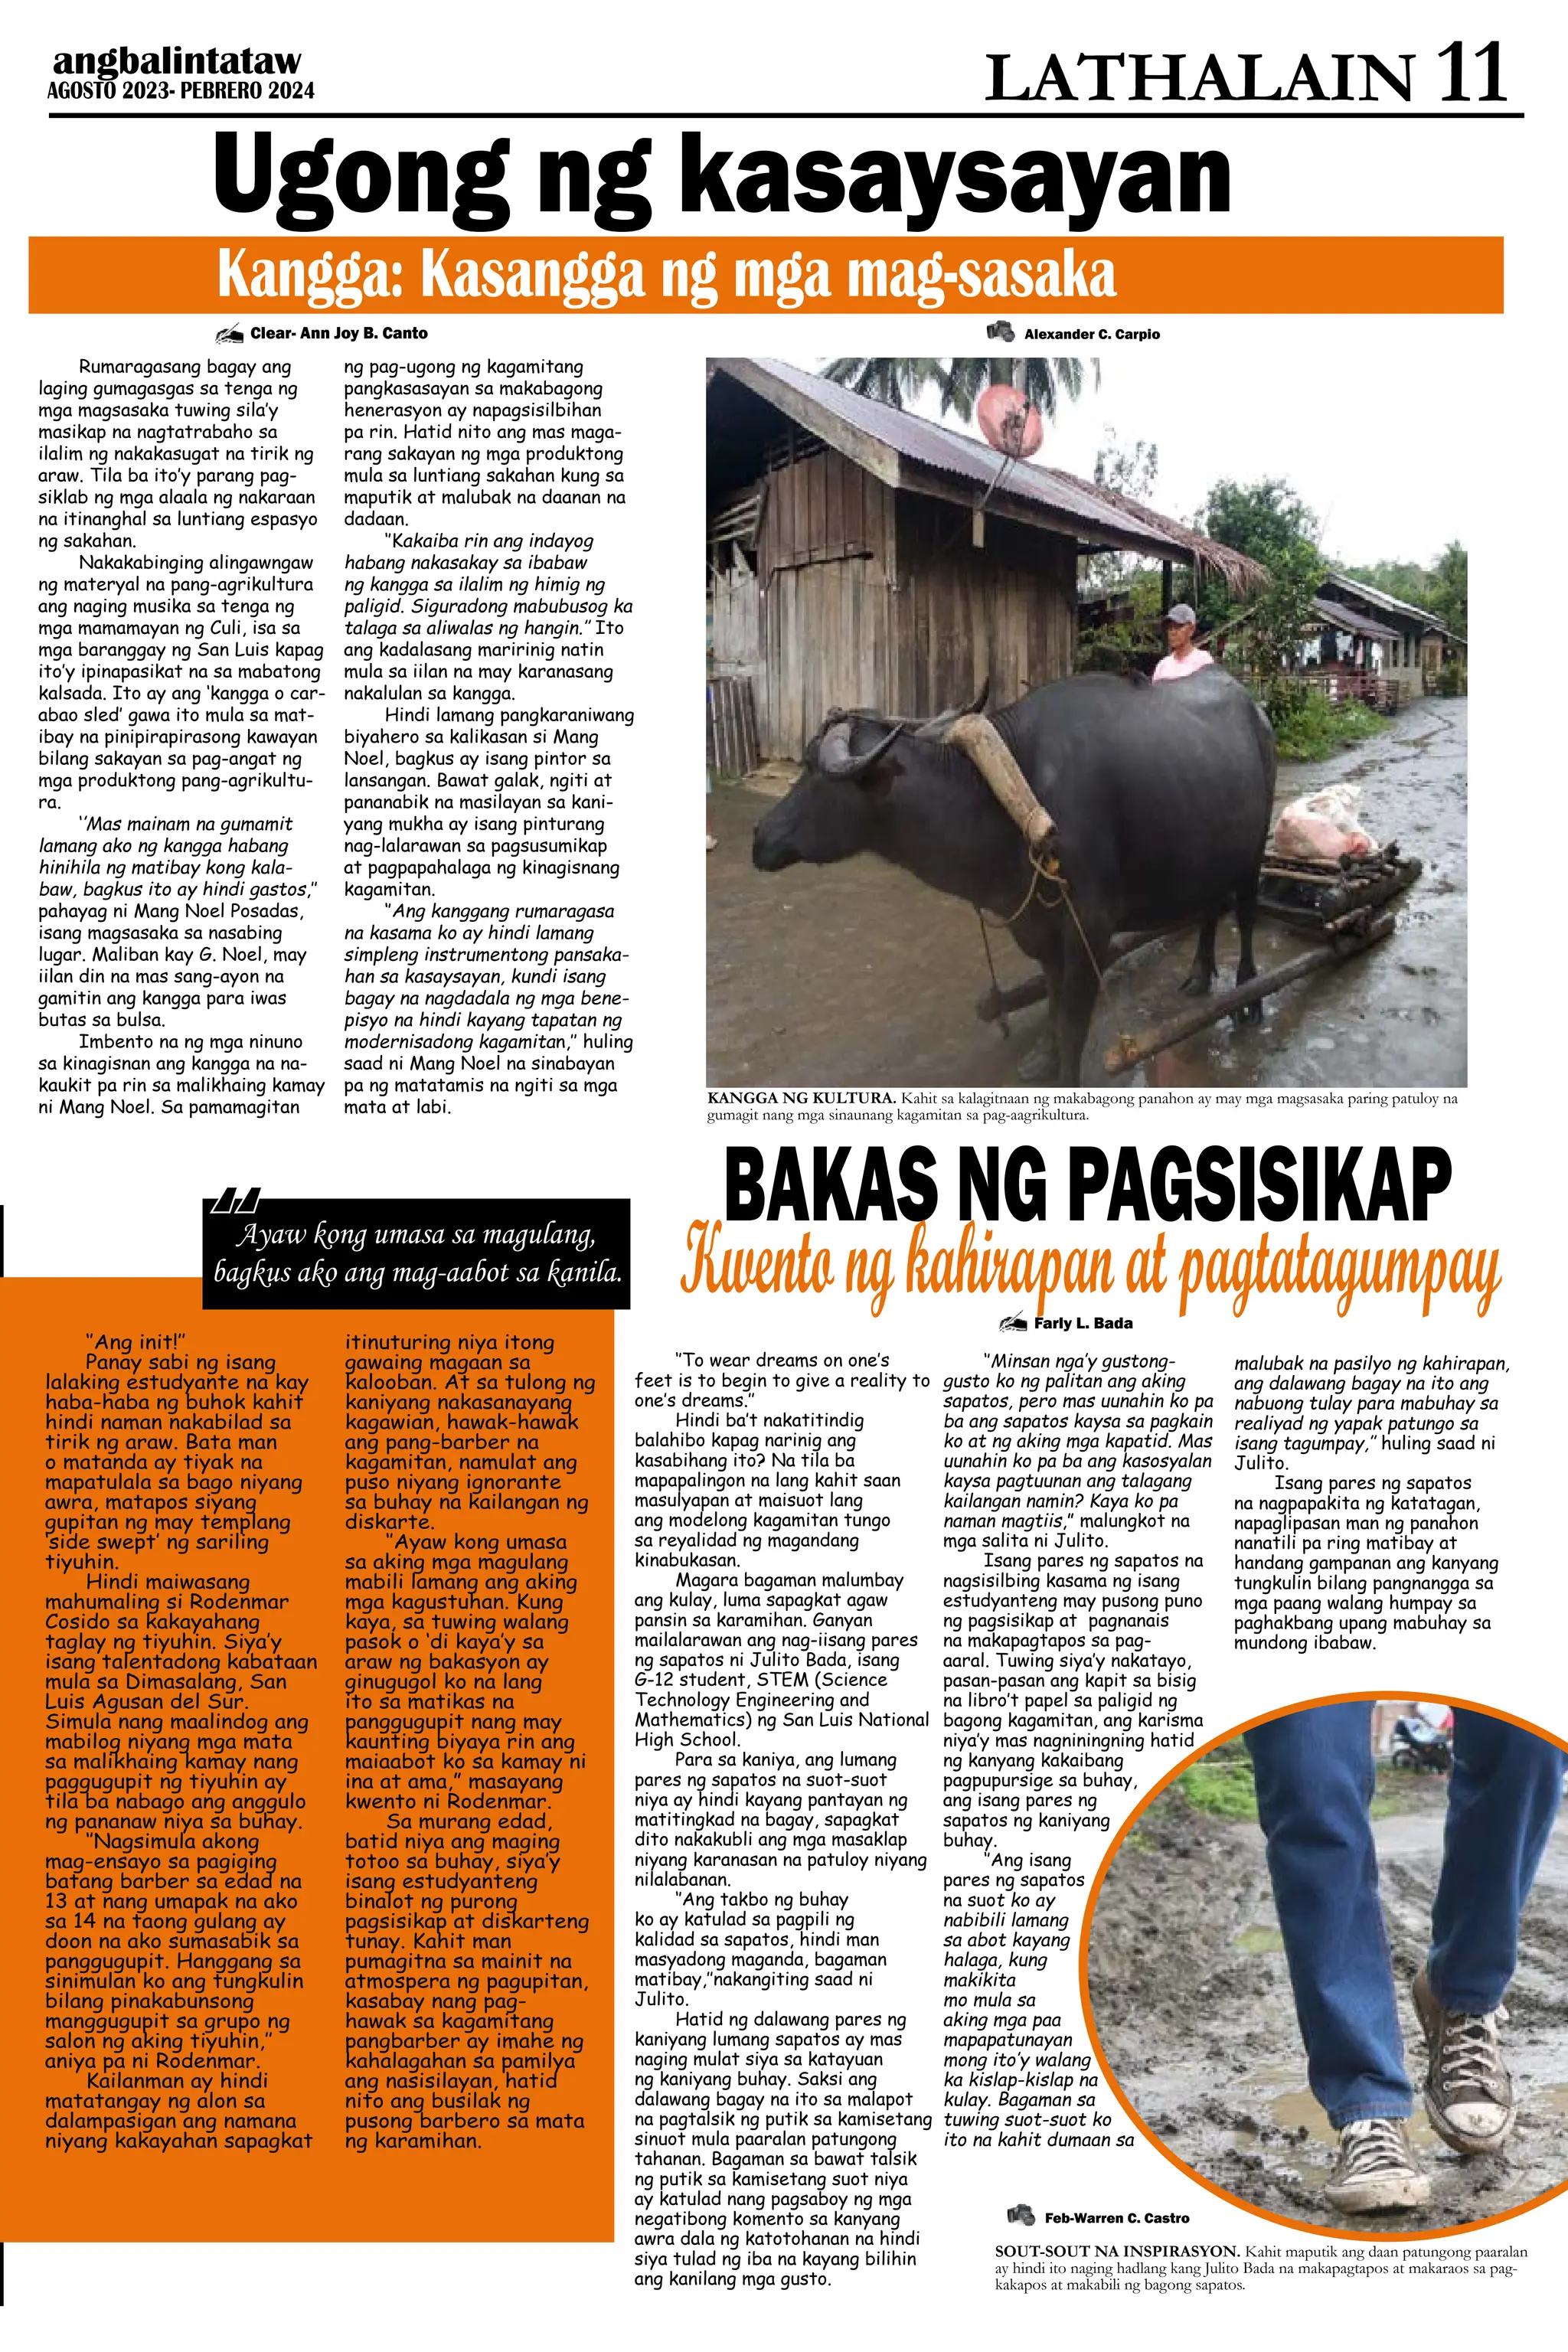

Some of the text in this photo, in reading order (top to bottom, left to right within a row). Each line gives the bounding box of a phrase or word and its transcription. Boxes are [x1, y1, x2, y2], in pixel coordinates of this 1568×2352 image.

[53, 45, 302, 81] angbalintataw
[985, 41, 1508, 102] LATHALAIN 11
[47, 80, 315, 100] AGOSTO 2023- PEBRERO 2024
[215, 131, 1230, 233] Ugong ng kasaysayan
[219, 247, 1118, 309] Kangga: Kasangga ng mga mag-sasaka
[250, 326, 429, 342] Clear- Ann Joy B. Canto
[1024, 328, 1161, 342] Alexander C. Carpio
[80, 358, 292, 378] Rumaragasang bagay ang
[345, 358, 583, 378] ng pag-ugong ng kagamitang
[39, 379, 298, 400] laging gumagasgas sa tenga ng
[345, 1098, 451, 1115] mata at labi.
[707, 1091, 1459, 1108] KANGGA NG KULTURA. Kahit sa kalagitnaan ng makabagong panahon ay may mga magsasaka paring patuloy na
[707, 1108, 1089, 1125] gumagit nang mga sinaunang kagamitan sa pag-aagrikultura.
[726, 1145, 1452, 1223] BAKAS NG PAGSISIKAP
[235, 1220, 595, 1252] Ayaw kong umasa sa magulang,
[214, 1258, 621, 1290] bagkus ako ang mag-aabot sa kanila.
[680, 1219, 1503, 1318] Kwento ng kahirapan at pagtatagumpay
[1034, 1317, 1133, 1332] Farly L. Bada
[346, 1334, 554, 1355] itinuturing niya itong
[86, 1353, 276, 1375] Panay sabi ng isang
[1234, 1354, 1510, 1378] malubak na pasilyo ng kahirapan,
[942, 1372, 1186, 1393] gusto ko ng palitan ang aking
[635, 1431, 856, 1452] balahibo kapag narinig ang
[1234, 1633, 1377, 1655] mundong ibabaw.
[45, 2131, 313, 2154] niyang kakayahan sapagkat
[345, 2131, 482, 2154] ng karamihan.
[944, 2131, 1135, 2148] ito na kahit dumaan sa
[1045, 2213, 1191, 2224] Feb-Warren C. Castro
[995, 2245, 1528, 2262] SOUT-SOUT NA INSPIRASYON. Kahit maputik ang daan patungong paaralan
[634, 2269, 831, 2291] ang kanilang mga gusto.
[995, 2262, 1517, 2278] ay hindi ito naging hadlang kang Julito Bada na makapagtapos at makaraos sa pag-
[995, 2278, 1245, 2295] kakapos at makabili ng bagong sapatos.
